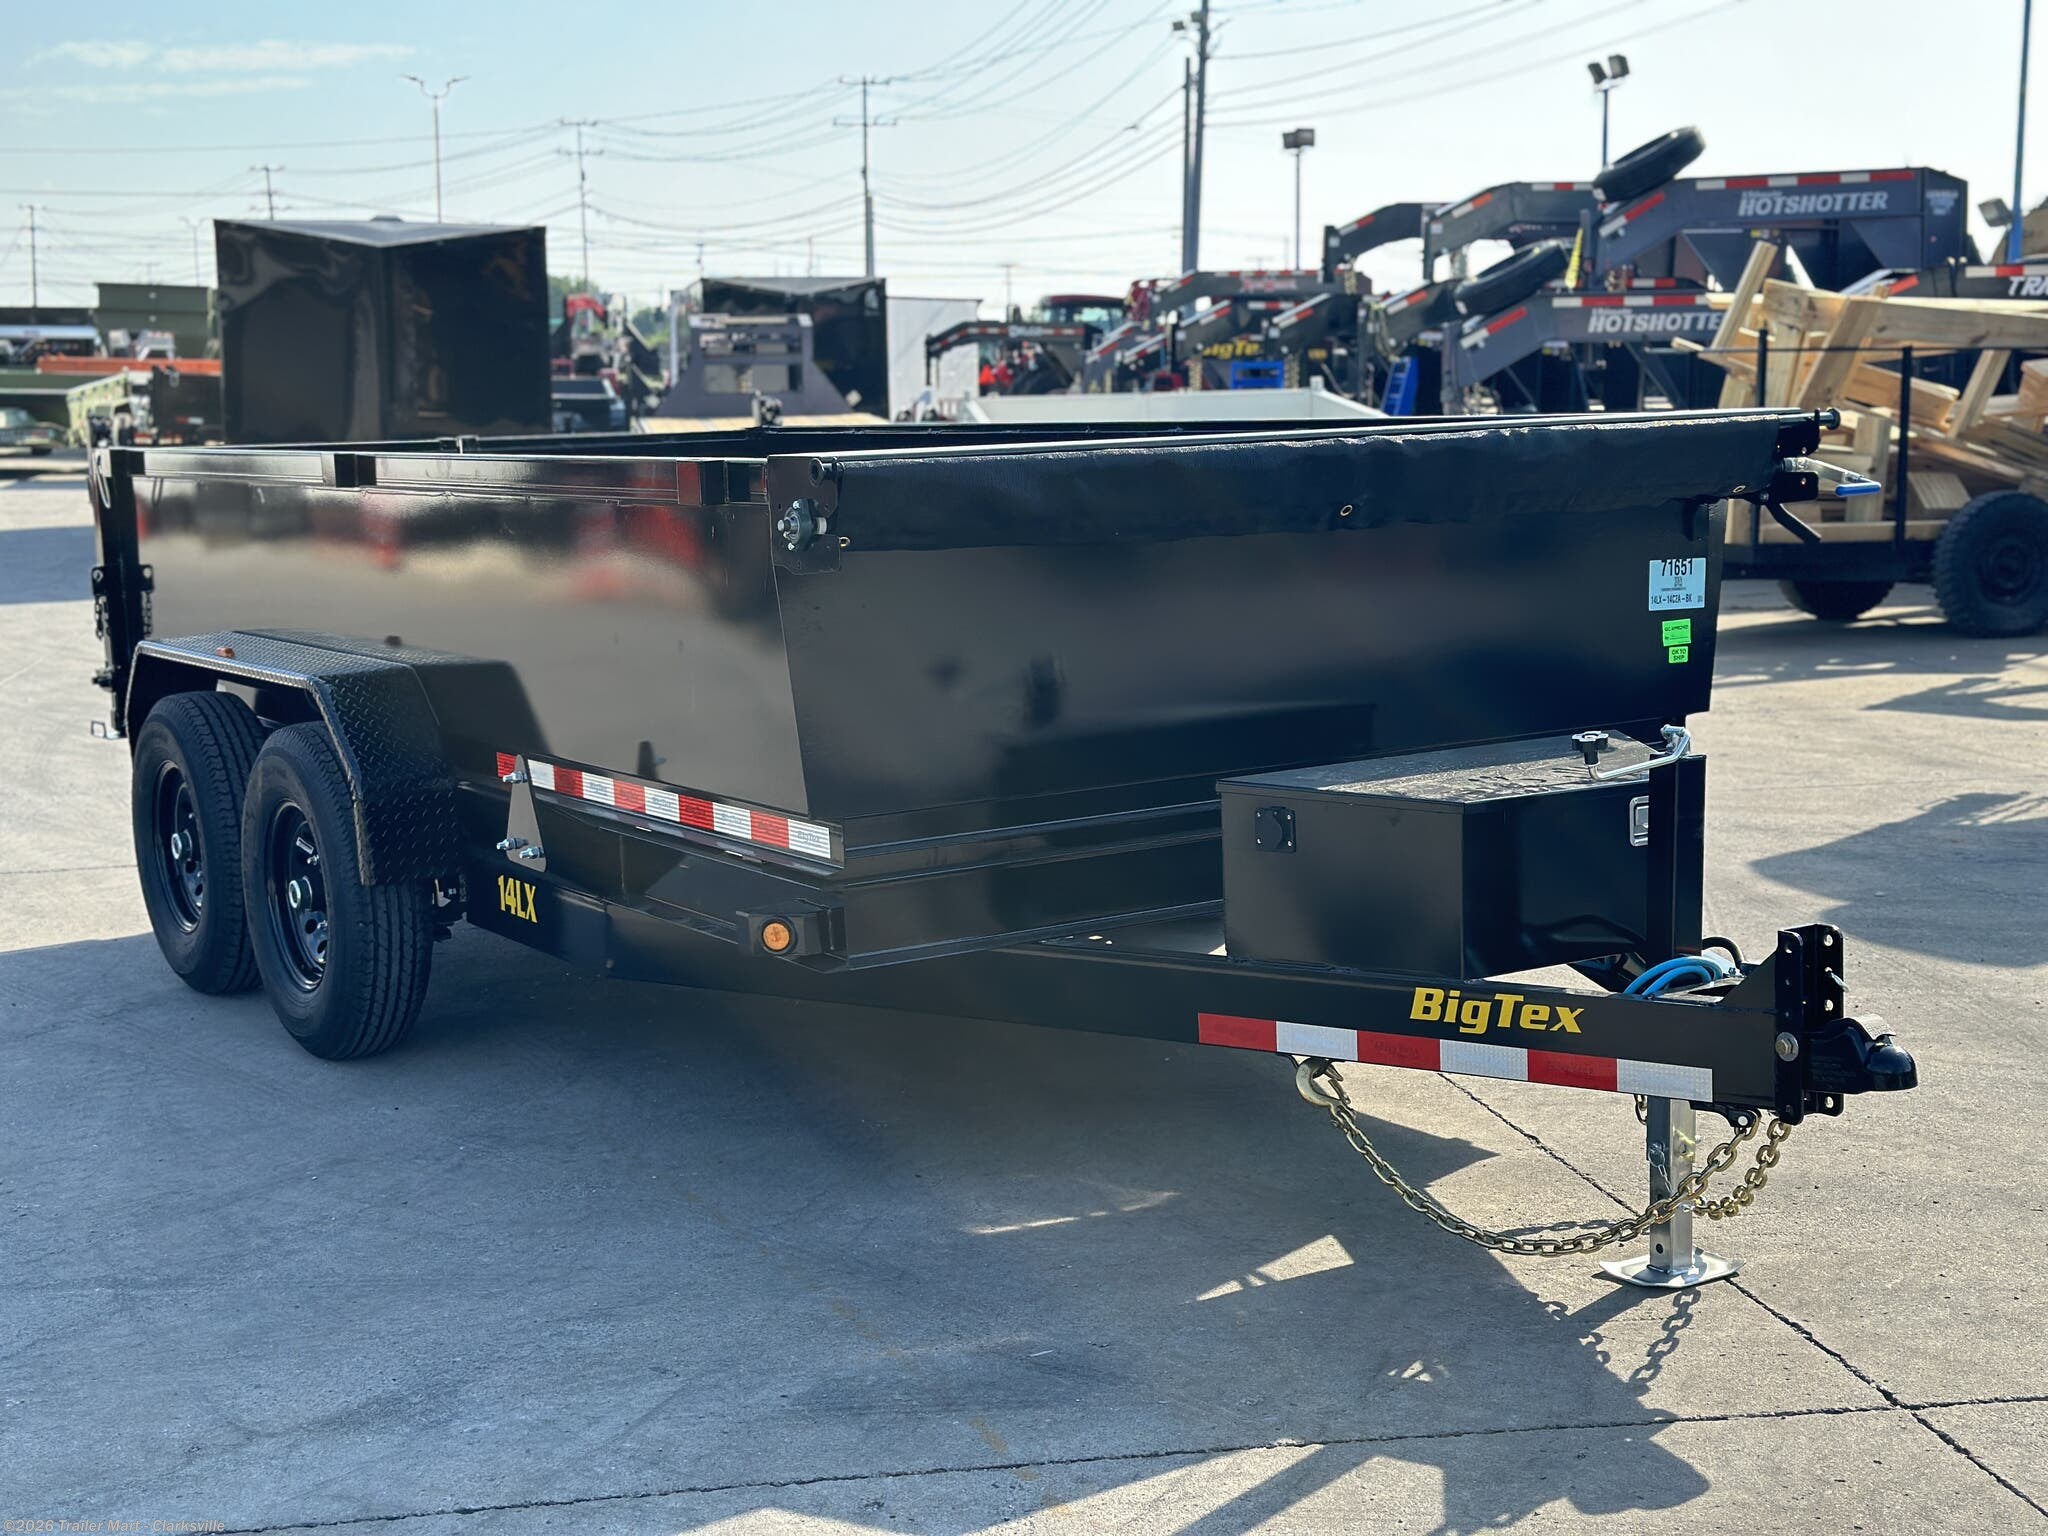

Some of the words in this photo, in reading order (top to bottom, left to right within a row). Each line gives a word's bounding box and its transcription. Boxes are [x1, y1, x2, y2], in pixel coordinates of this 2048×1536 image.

[1738, 191, 1888, 217] HOTSHOTTER
[1587, 311, 1725, 333] HOTSHOTTE
[1661, 558, 1693, 576] 71651
[498, 874, 538, 924] 14LX
[1409, 986, 1585, 1035] BigTex
